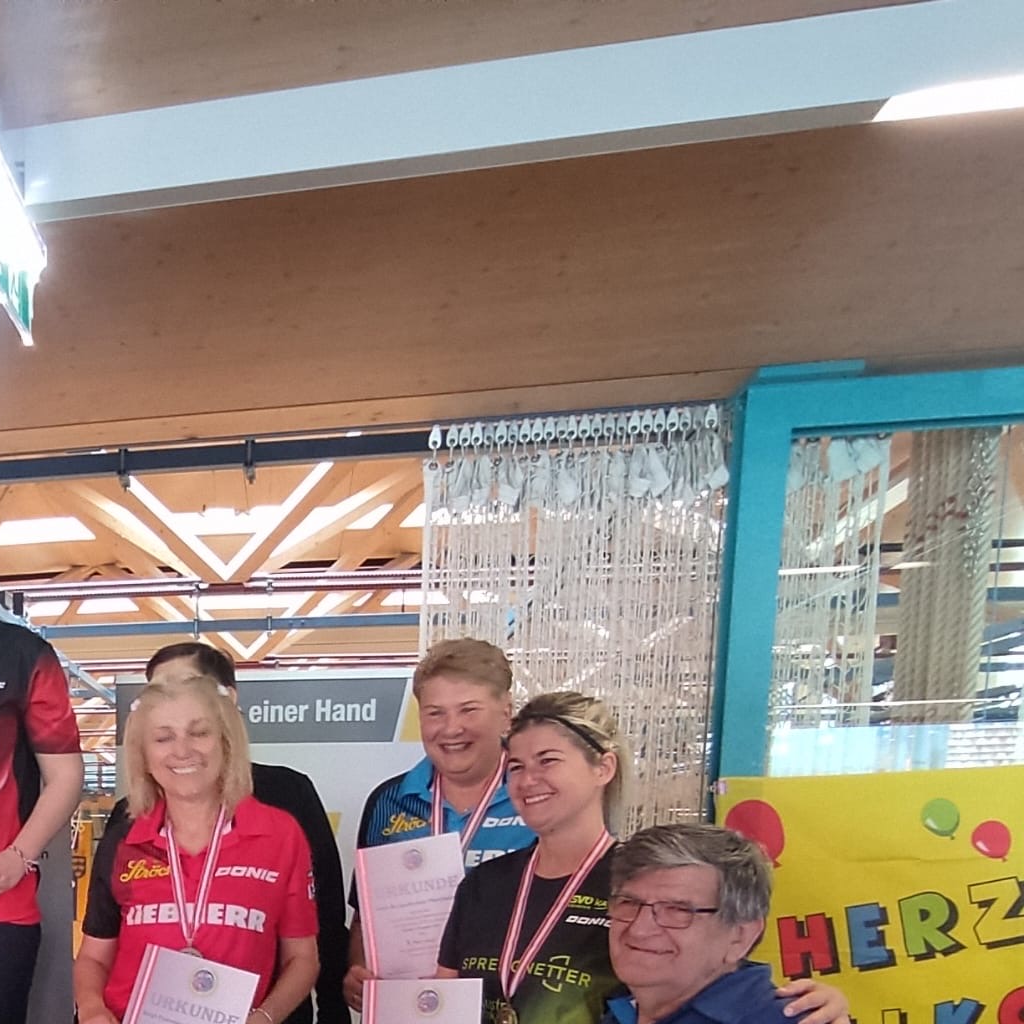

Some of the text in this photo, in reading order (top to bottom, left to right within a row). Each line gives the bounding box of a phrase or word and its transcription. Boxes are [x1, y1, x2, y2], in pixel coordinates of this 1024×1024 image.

[248, 698, 377, 724] einer Hand
[482, 816, 527, 829] DON
[215, 866, 280, 883] DONIC
[462, 956, 593, 988] SPREGNETTER
